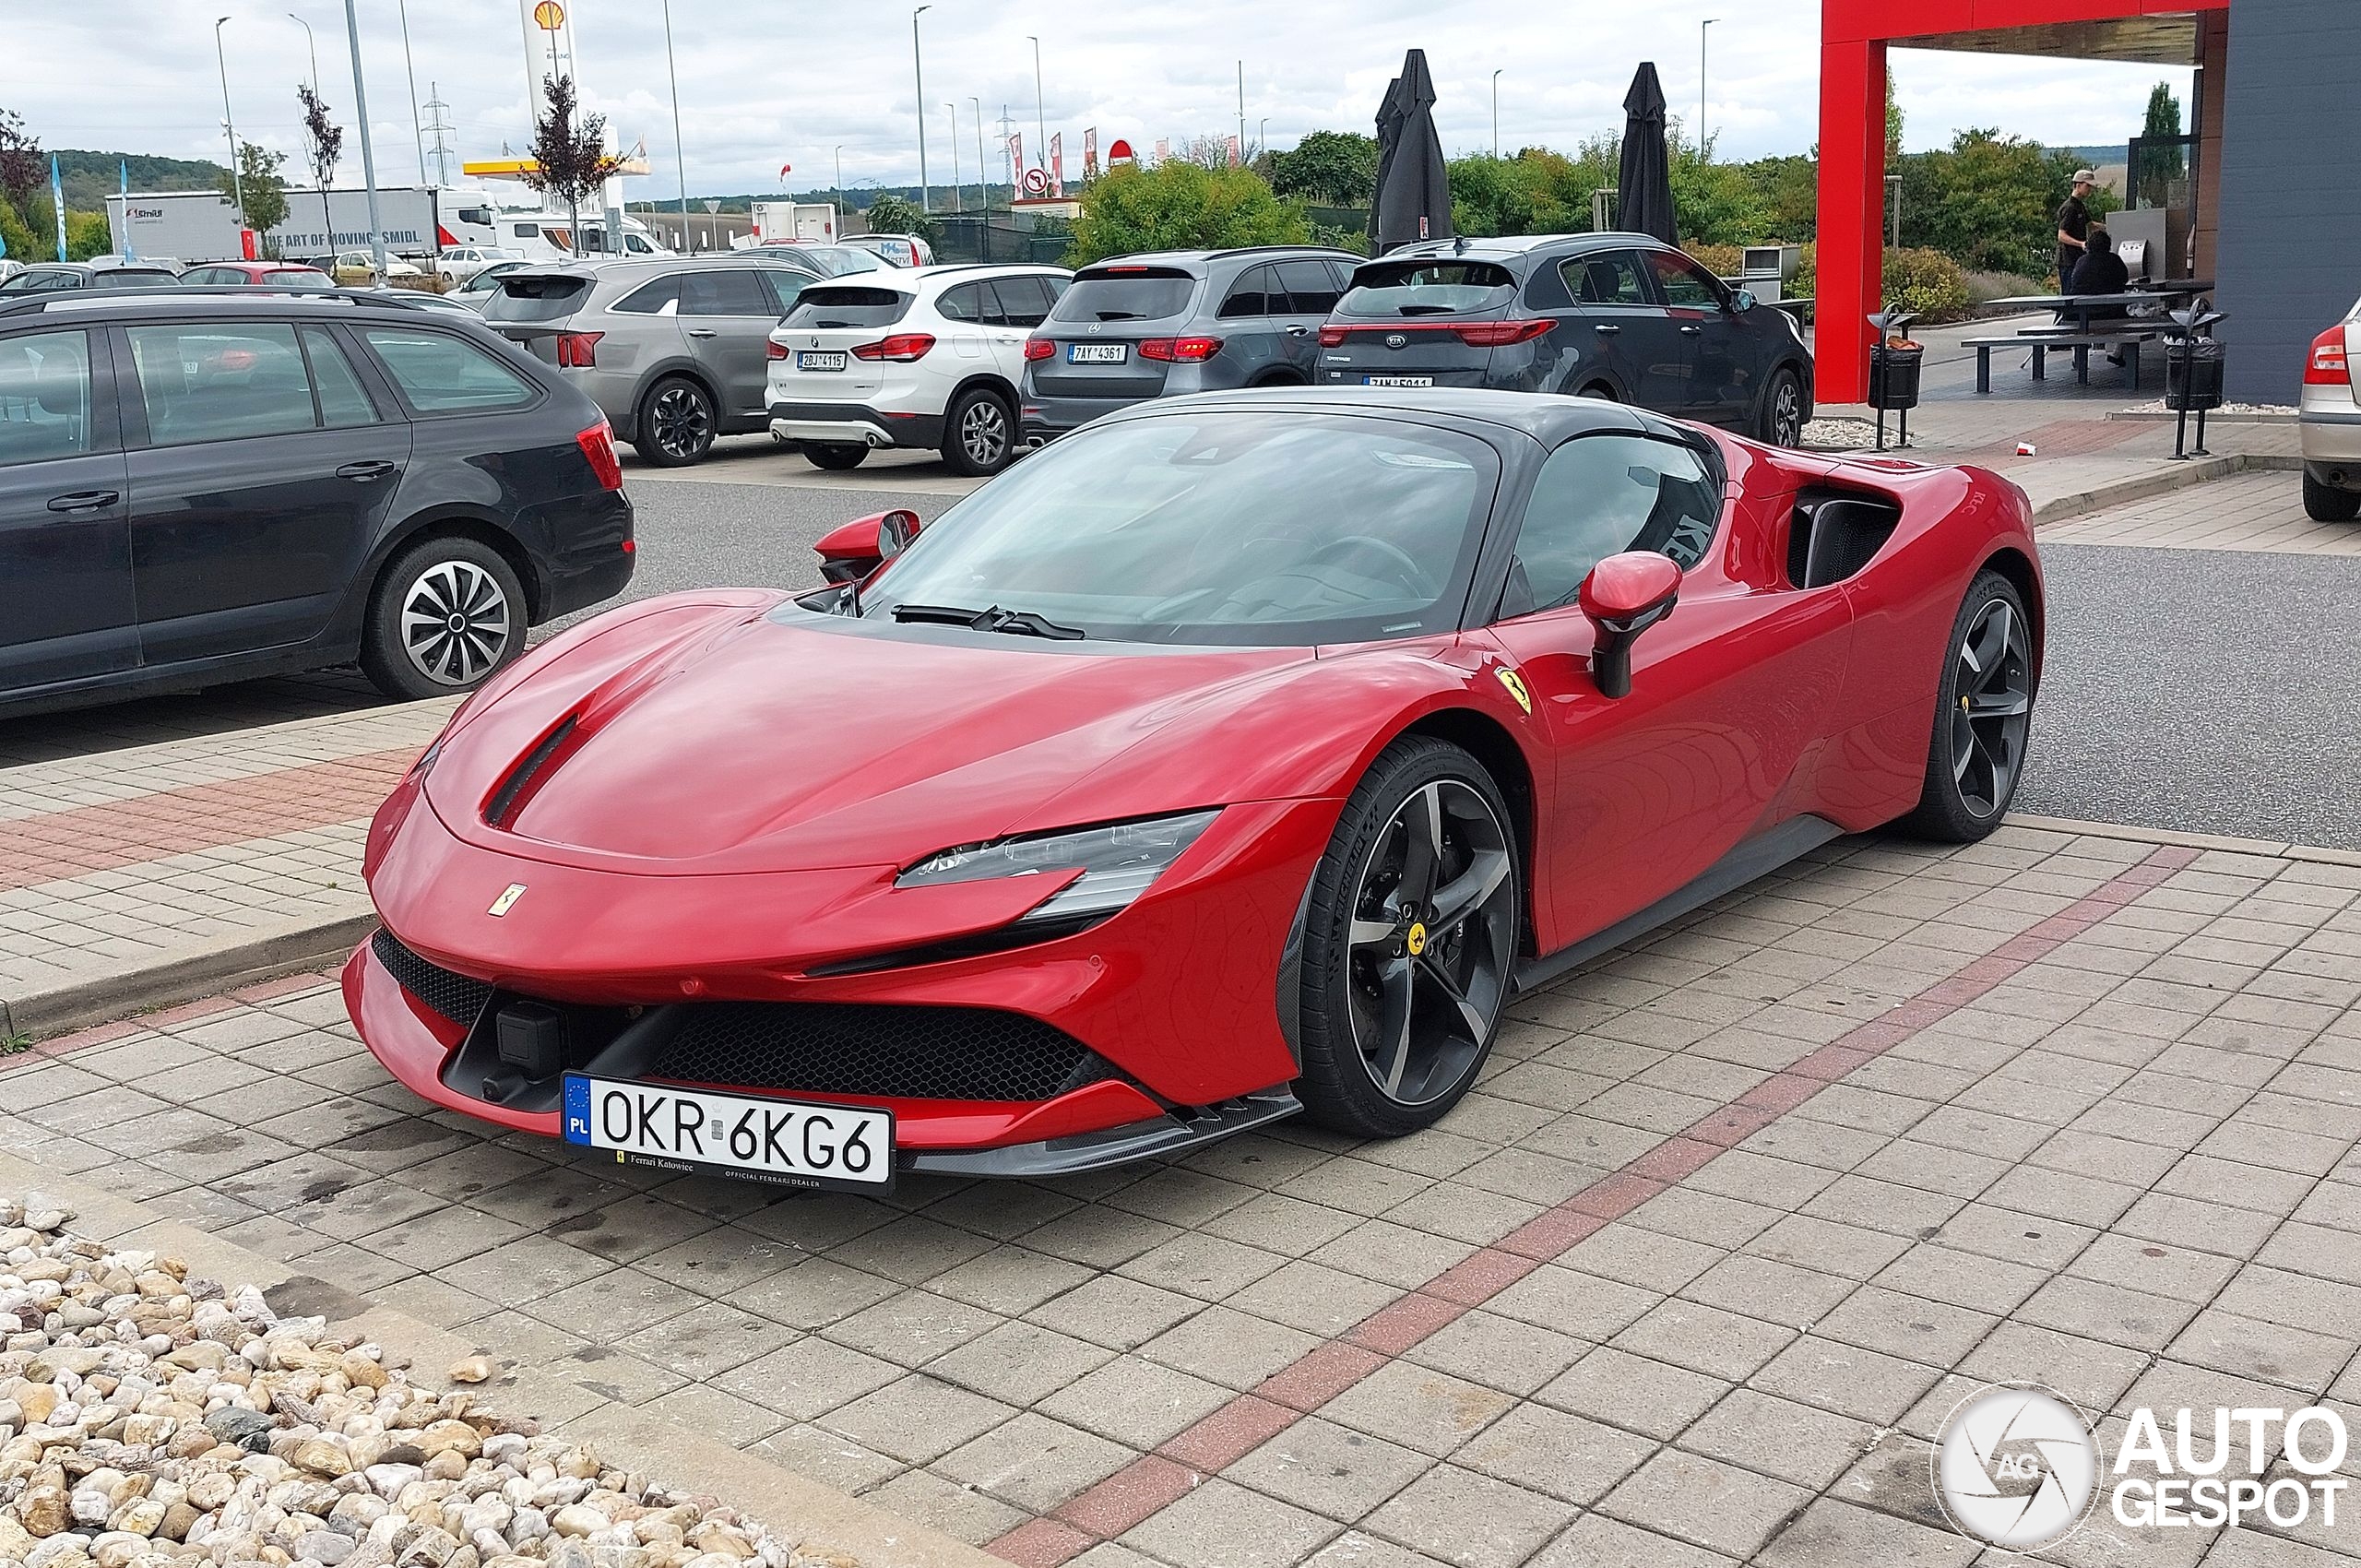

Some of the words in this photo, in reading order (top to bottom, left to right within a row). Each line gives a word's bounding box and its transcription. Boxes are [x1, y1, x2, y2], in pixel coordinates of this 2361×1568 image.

[286, 234, 308, 247] ART
[311, 233, 326, 247] OF
[823, 355, 842, 366] 4115
[1075, 347, 1092, 359] 7AY
[1097, 347, 1121, 359] 4361
[1335, 836, 1365, 921] MICHELIN
[570, 1117, 588, 1134] PL
[603, 1090, 705, 1156] OKR
[730, 1108, 871, 1173] 6KG6
[631, 1155, 656, 1167] Ferrari
[658, 1158, 694, 1172] Katowice
[725, 1170, 758, 1181] OFFICIAL
[759, 1175, 790, 1184] FERRARI
[791, 1179, 820, 1188] DEALER
